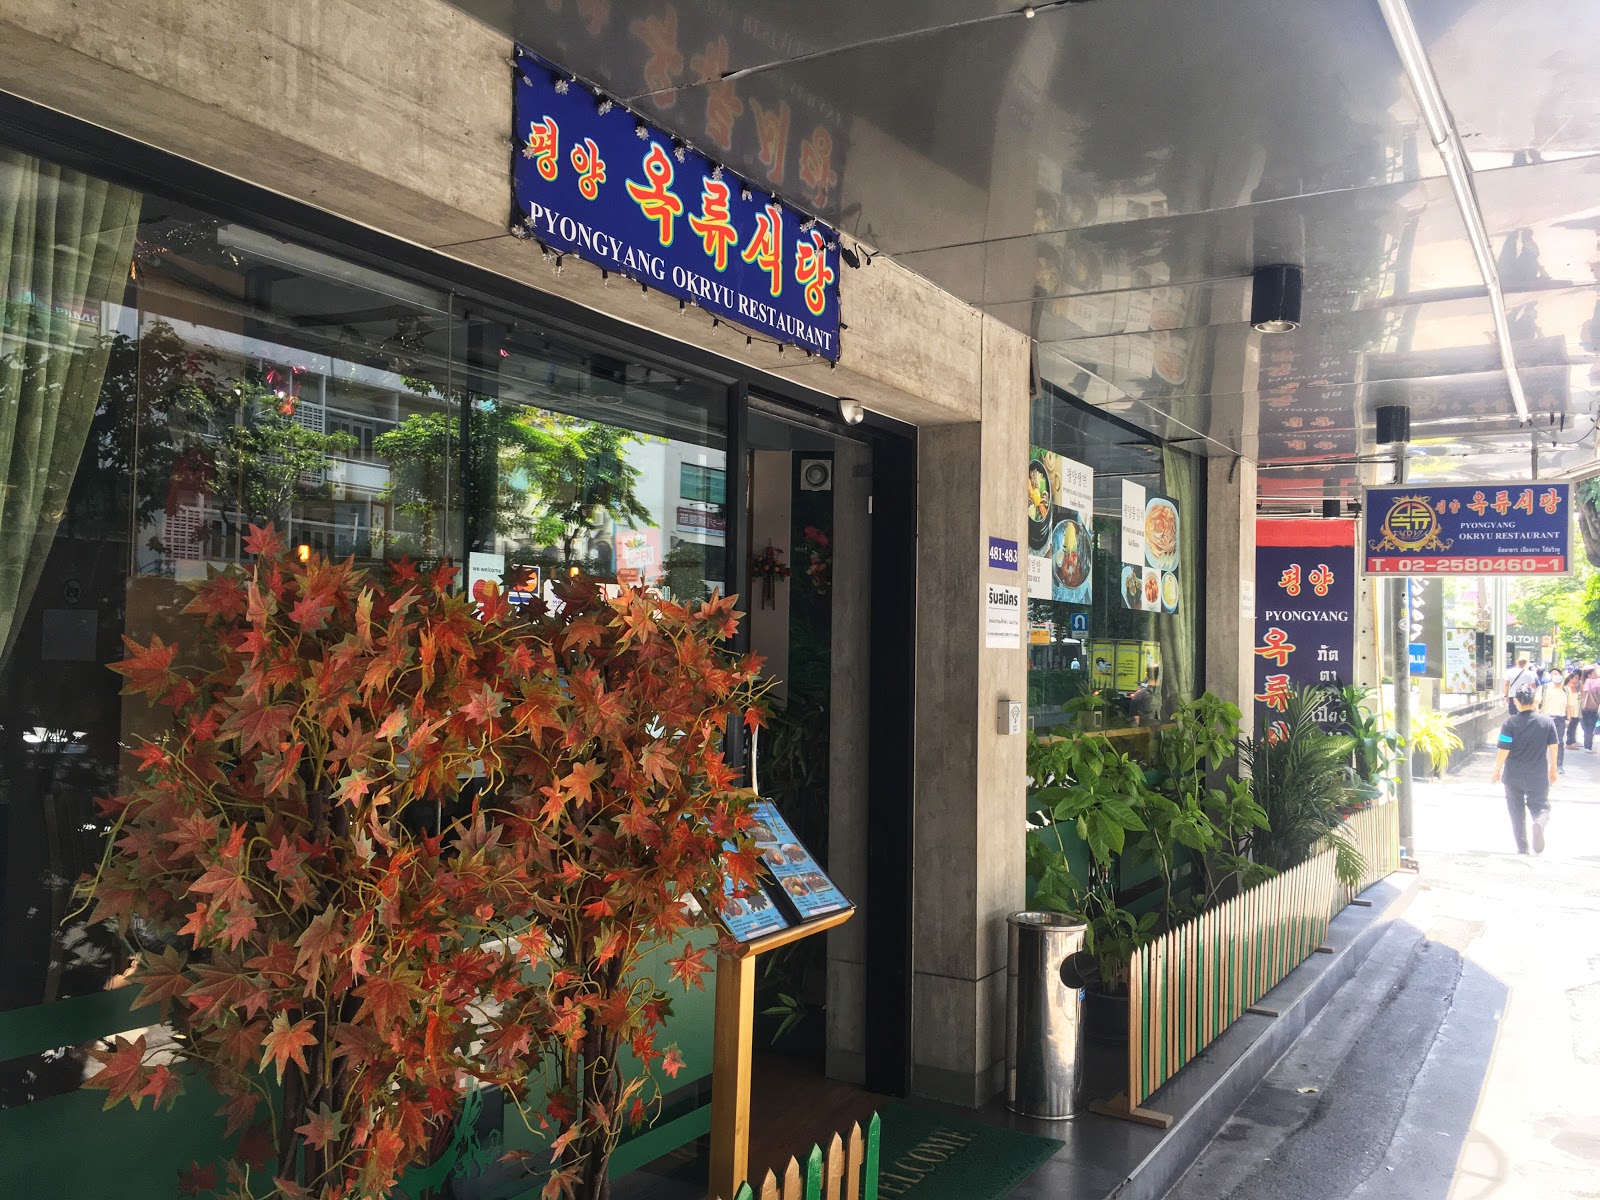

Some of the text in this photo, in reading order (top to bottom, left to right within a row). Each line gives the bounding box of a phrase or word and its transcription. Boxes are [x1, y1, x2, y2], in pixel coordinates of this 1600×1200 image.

[530, 115, 835, 316] 평양 옥류식당
[529, 200, 832, 351] PYONGYANG OKRYU RESTAURANT
[1466, 488, 1562, 516] 옥류식당
[1460, 521, 1516, 530] PYONGYANG
[1459, 531, 1561, 541] OKRYU RESTAURANT
[628, 549, 652, 565] OPEN
[989, 545, 1017, 563] 481-483
[1371, 558, 1560, 572] T. 02-2580460-1
[1277, 563, 1335, 597] 평양
[988, 587, 1018, 607] รับสมัคร
[1265, 610, 1349, 622] PYONGYANG
[1507, 635, 1539, 643] RLTON
